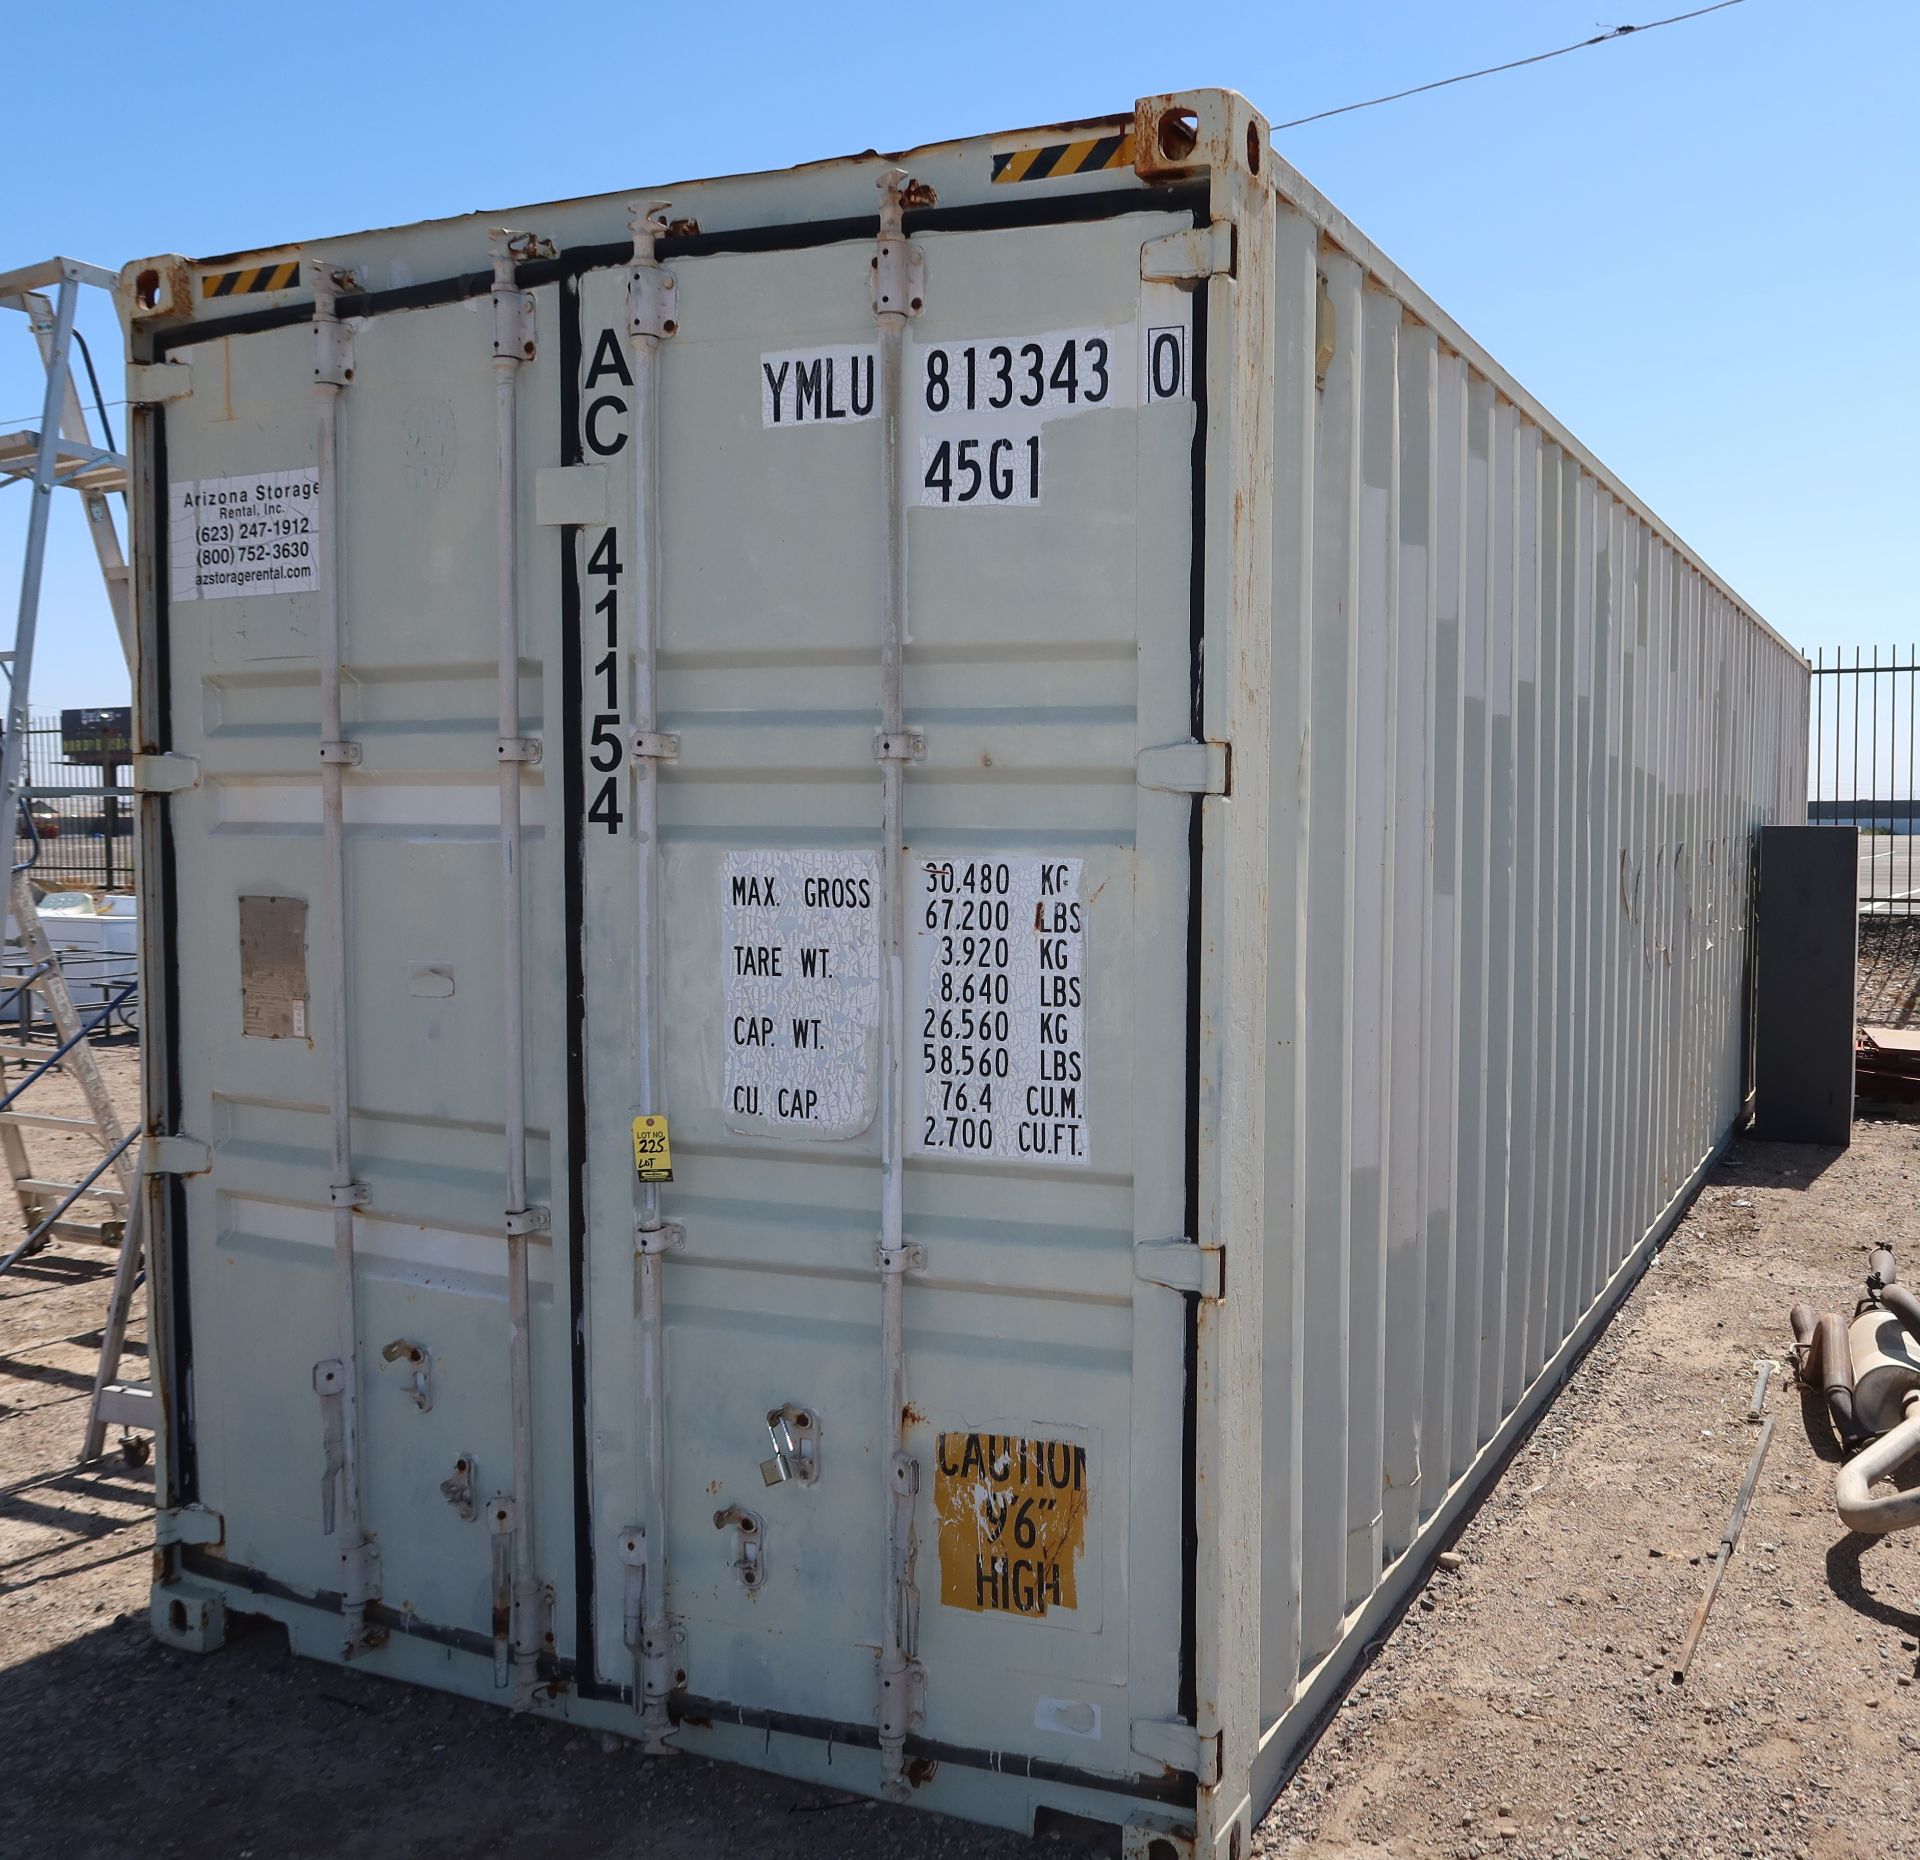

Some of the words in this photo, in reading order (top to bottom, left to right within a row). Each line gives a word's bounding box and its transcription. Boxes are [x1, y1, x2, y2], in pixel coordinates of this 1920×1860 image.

[584, 328, 634, 456] AC
[763, 355, 874, 422] YMLU
[926, 338, 1109, 412] 813343
[1152, 333, 1181, 398] 0
[924, 435, 1039, 503] 45G1
[184, 490, 248, 508] Arizona
[256, 482, 319, 500] Storage
[264, 503, 285, 515] Inc.
[195, 523, 234, 546] (623)
[240, 517, 309, 540] 247-1912
[196, 547, 235, 568] (800)
[238, 541, 309, 563] 752-3630
[195, 566, 311, 586] azstoragerental.com
[587, 526, 623, 835] 41154
[732, 876, 780, 907] MAX.
[804, 877, 871, 909] GROSS
[926, 862, 1009, 894] 30,480
[926, 899, 1009, 931] 67,200
[1039, 902, 1081, 934] LBS
[733, 945, 782, 977] TARE
[800, 948, 833, 979] WT.
[941, 936, 1009, 968] 3,920
[1040, 938, 1068, 970] KG
[941, 972, 1009, 1005] 8,640
[1040, 975, 1081, 1008] LBS
[733, 1016, 775, 1047] CAP.
[792, 1018, 825, 1050] WT.
[923, 1007, 1009, 1042] 26,560
[1040, 1012, 1068, 1045] KG
[923, 1043, 1009, 1078] 58,560
[1040, 1050, 1082, 1082] LBS
[733, 1085, 763, 1116] CU.
[777, 1088, 819, 1120] CAP.
[940, 1080, 992, 1114] 76.4
[1026, 1085, 1083, 1119] CU.M.
[636, 1131, 651, 1140] LOT
[638, 1136, 666, 1153] 225
[923, 1116, 993, 1150] 2,700
[1018, 1121, 1083, 1156] CU.FT.
[638, 1158, 656, 1169] LOT
[976, 1553, 1060, 1614] HIGH
